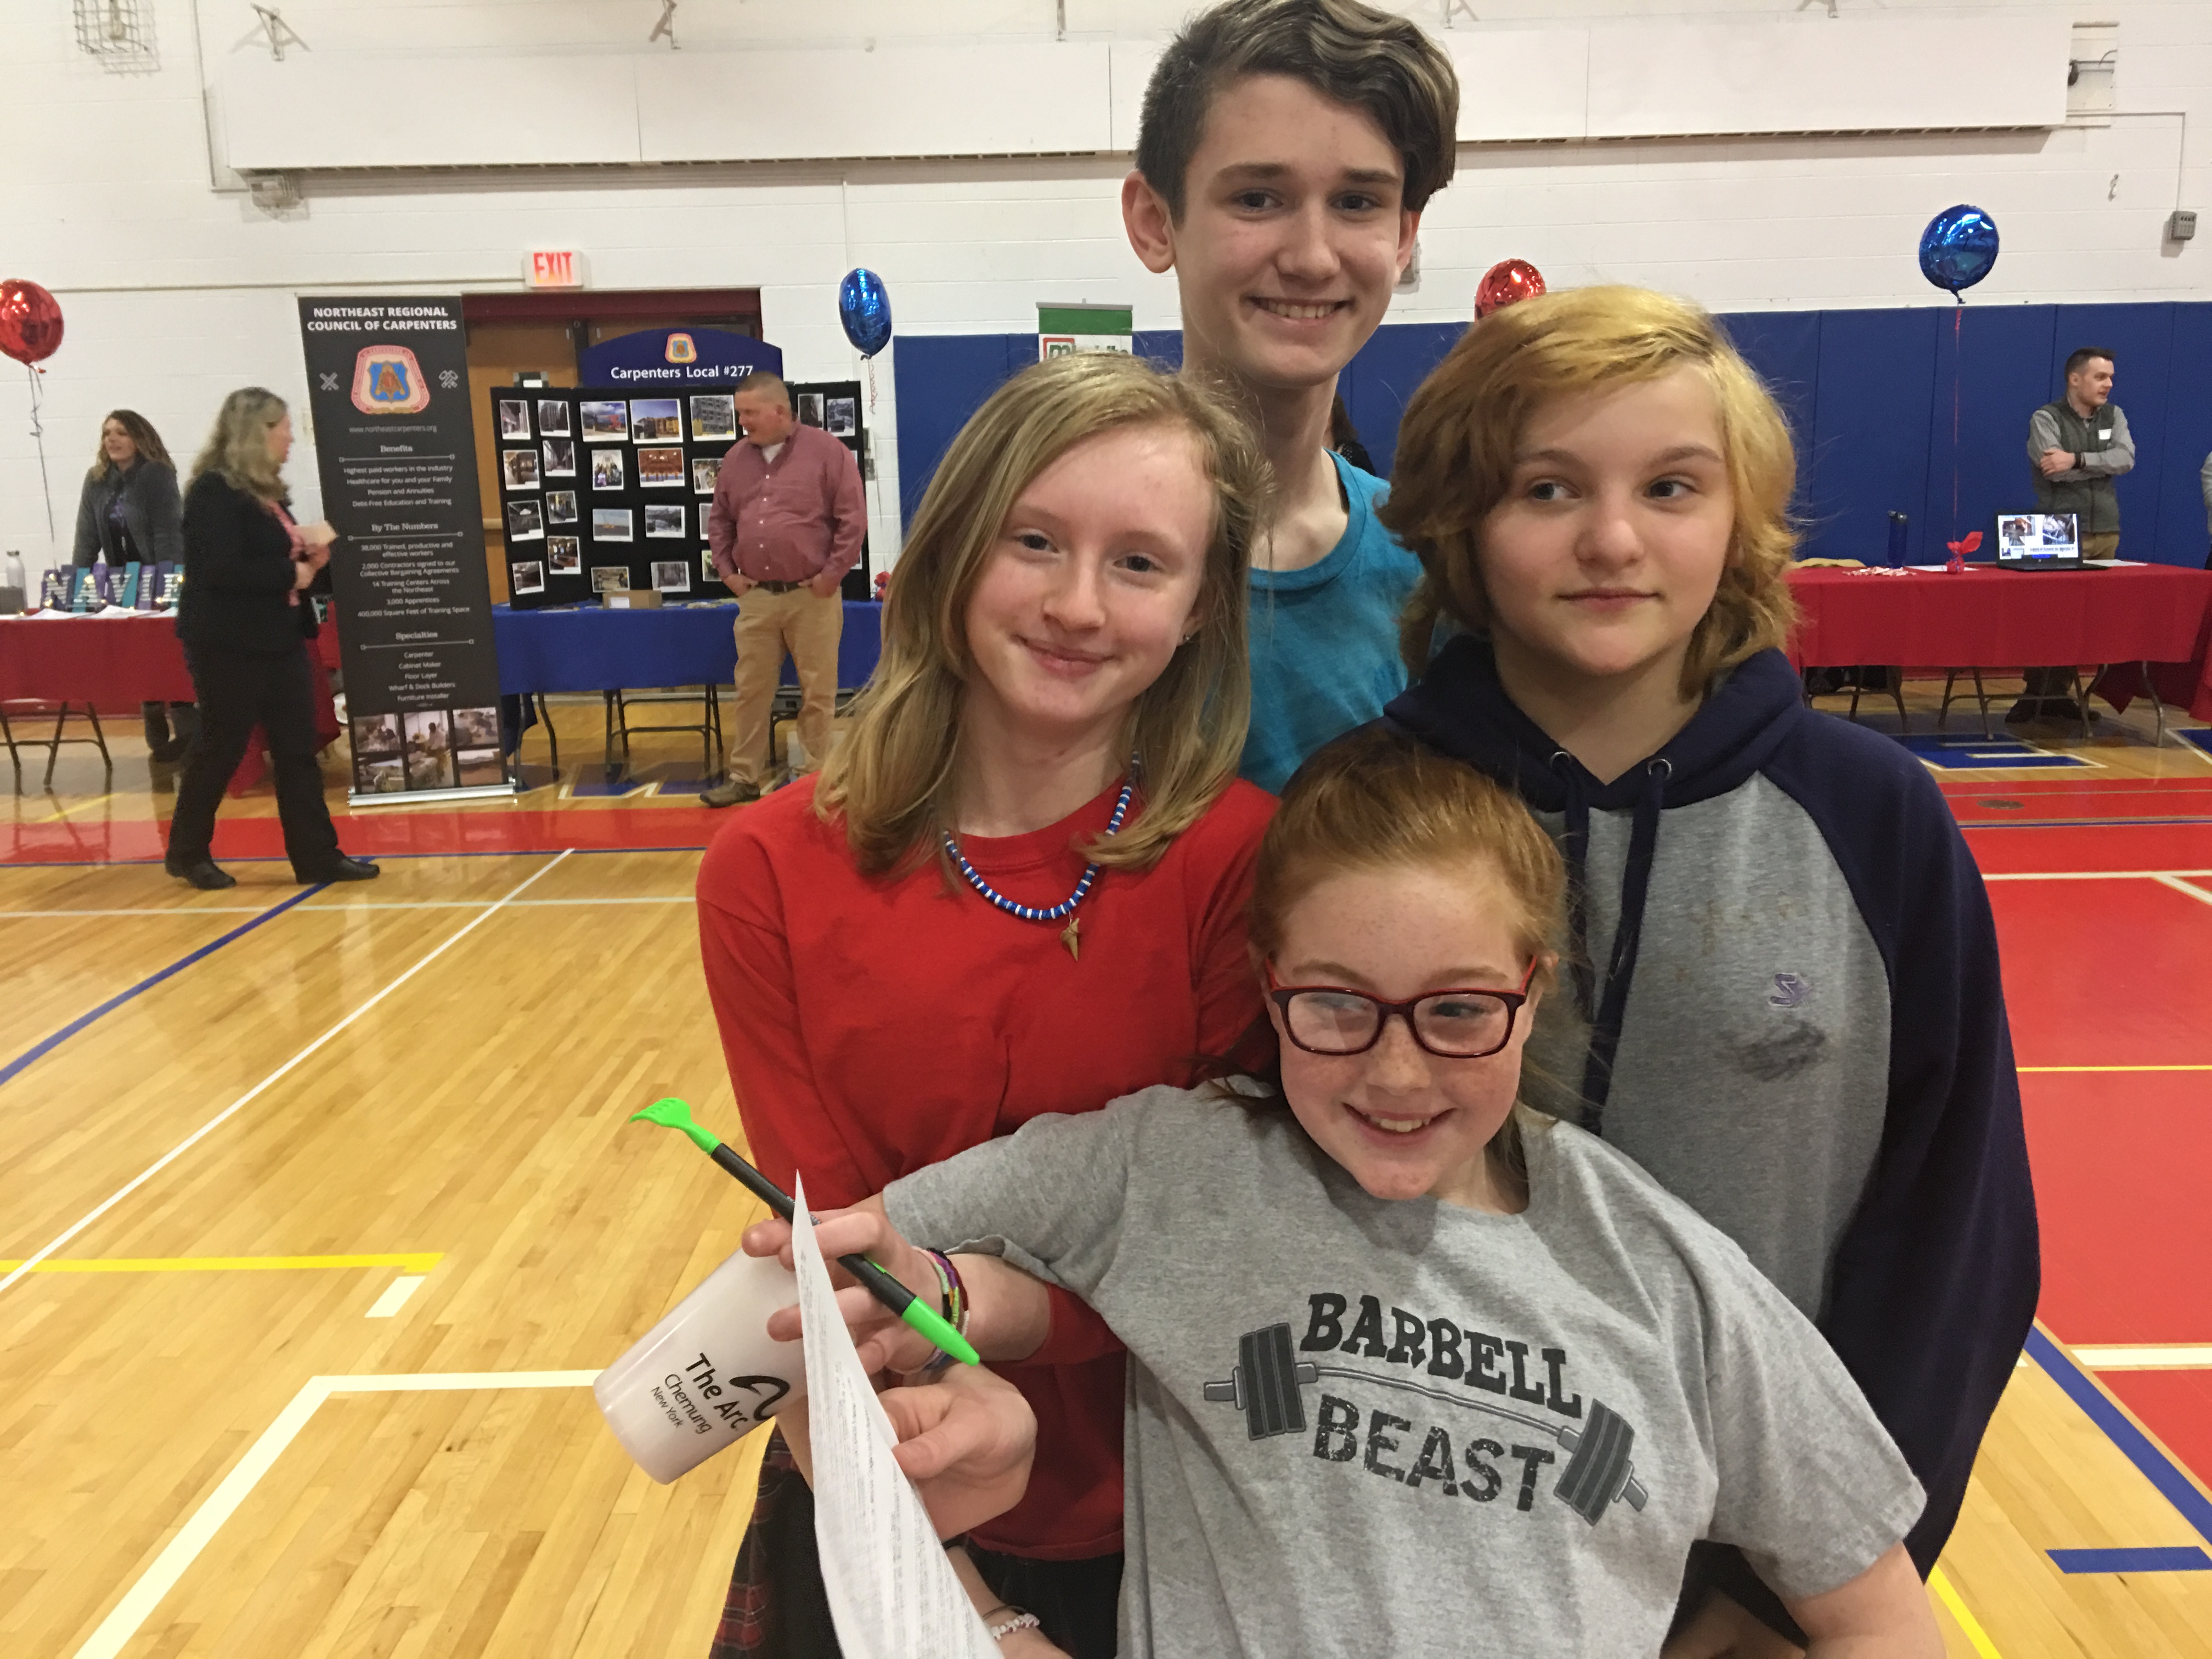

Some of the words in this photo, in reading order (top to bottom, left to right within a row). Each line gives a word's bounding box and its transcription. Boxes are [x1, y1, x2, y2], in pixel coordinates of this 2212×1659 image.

[534, 252, 573, 284] EXIT
[313, 307, 385, 317] NORTHEAST
[387, 307, 448, 317] REGIONAL
[307, 321, 362, 331] COUNCIL
[364, 320, 380, 330] OF
[382, 320, 457, 330] CARPENTERS
[611, 367, 681, 381] Carpenters
[686, 365, 719, 378] Local
[724, 365, 753, 377] #277
[371, 524, 382, 533] By
[383, 609, 404, 617] Square
[396, 631, 438, 641] Specialties
[1300, 1293, 1582, 1419] BARBELL
[685, 1352, 723, 1400] The
[713, 1400, 748, 1429] Arc
[651, 1386, 669, 1409] New
[665, 1406, 684, 1428] York
[664, 1374, 712, 1435] Chemung
[1313, 1393, 1555, 1512] BEAST
